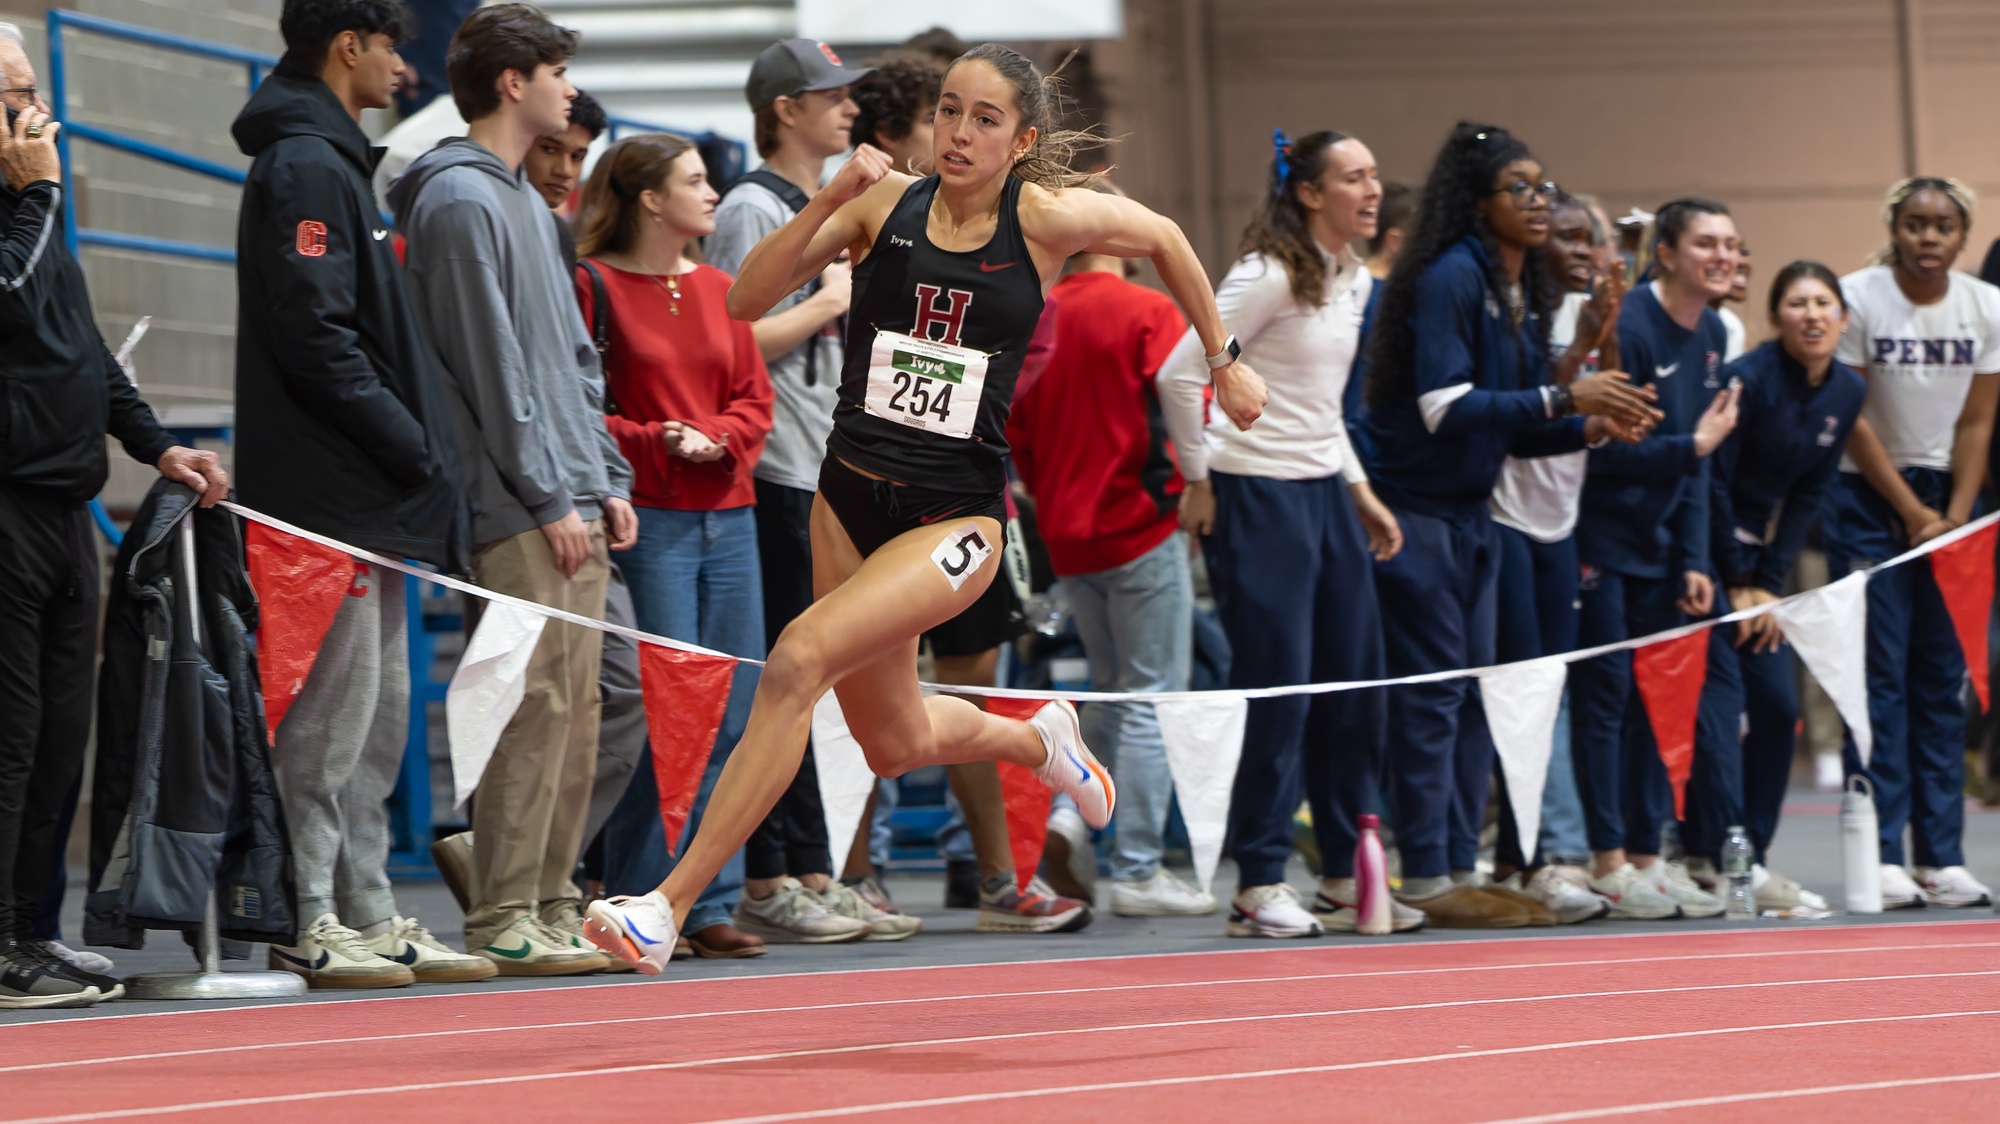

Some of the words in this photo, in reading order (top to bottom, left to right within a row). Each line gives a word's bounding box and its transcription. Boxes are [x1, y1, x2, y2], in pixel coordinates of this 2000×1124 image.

[890, 234, 906, 247] Ivy
[909, 283, 973, 347] H
[910, 355, 935, 374] Ivy
[1873, 338, 1974, 365] PENN
[889, 371, 953, 423] 254
[941, 531, 987, 577] 5
